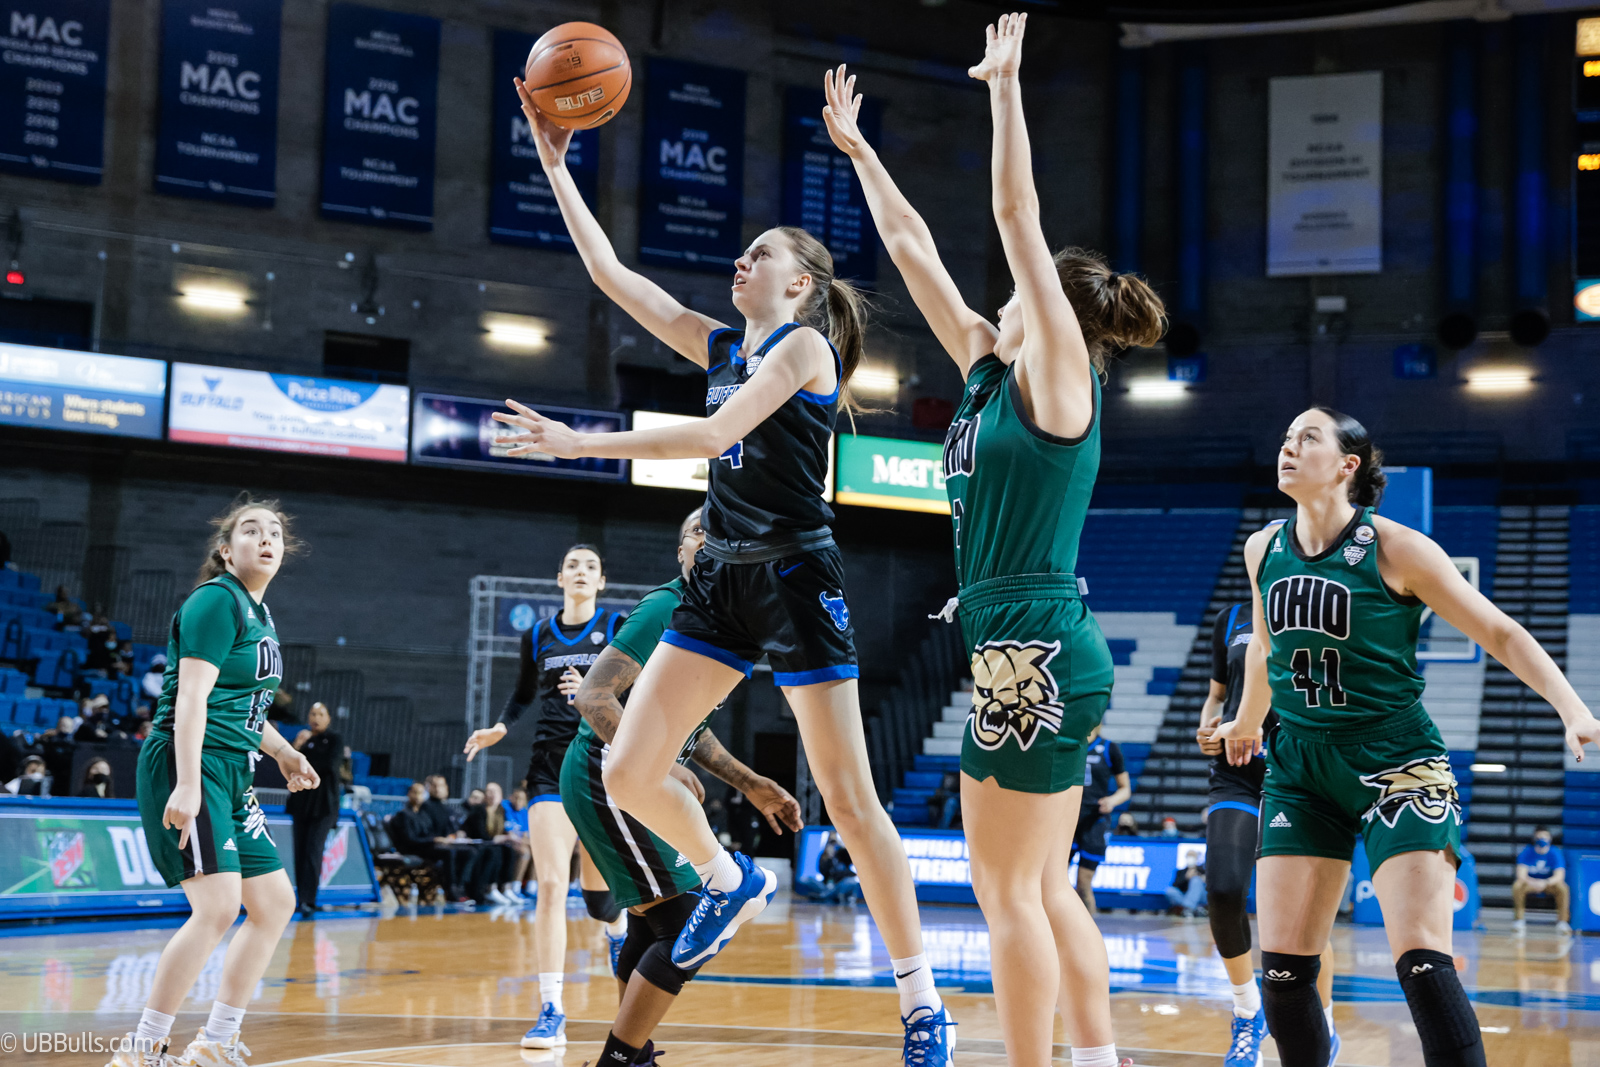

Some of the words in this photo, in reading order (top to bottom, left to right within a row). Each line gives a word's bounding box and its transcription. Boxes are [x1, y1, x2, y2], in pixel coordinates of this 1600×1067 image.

[10, 11, 84, 46] MAC
[180, 61, 261, 100] MAC
[180, 92, 260, 116] CHAMPIONS
[344, 88, 420, 126] MAC
[344, 118, 420, 140] CHAMPIONS
[659, 138, 728, 174] MAC
[63, 393, 99, 412] Where
[99, 400, 146, 417] students
[180, 392, 244, 412] BUFFALO
[287, 381, 327, 402] Price
[328, 385, 362, 406] Rite
[62, 408, 86, 423] love
[871, 453, 929, 489] M&T
[1267, 575, 1351, 640] OHIO
[1290, 648, 1347, 707] 41
[1269, 820, 1292, 828] adidas
